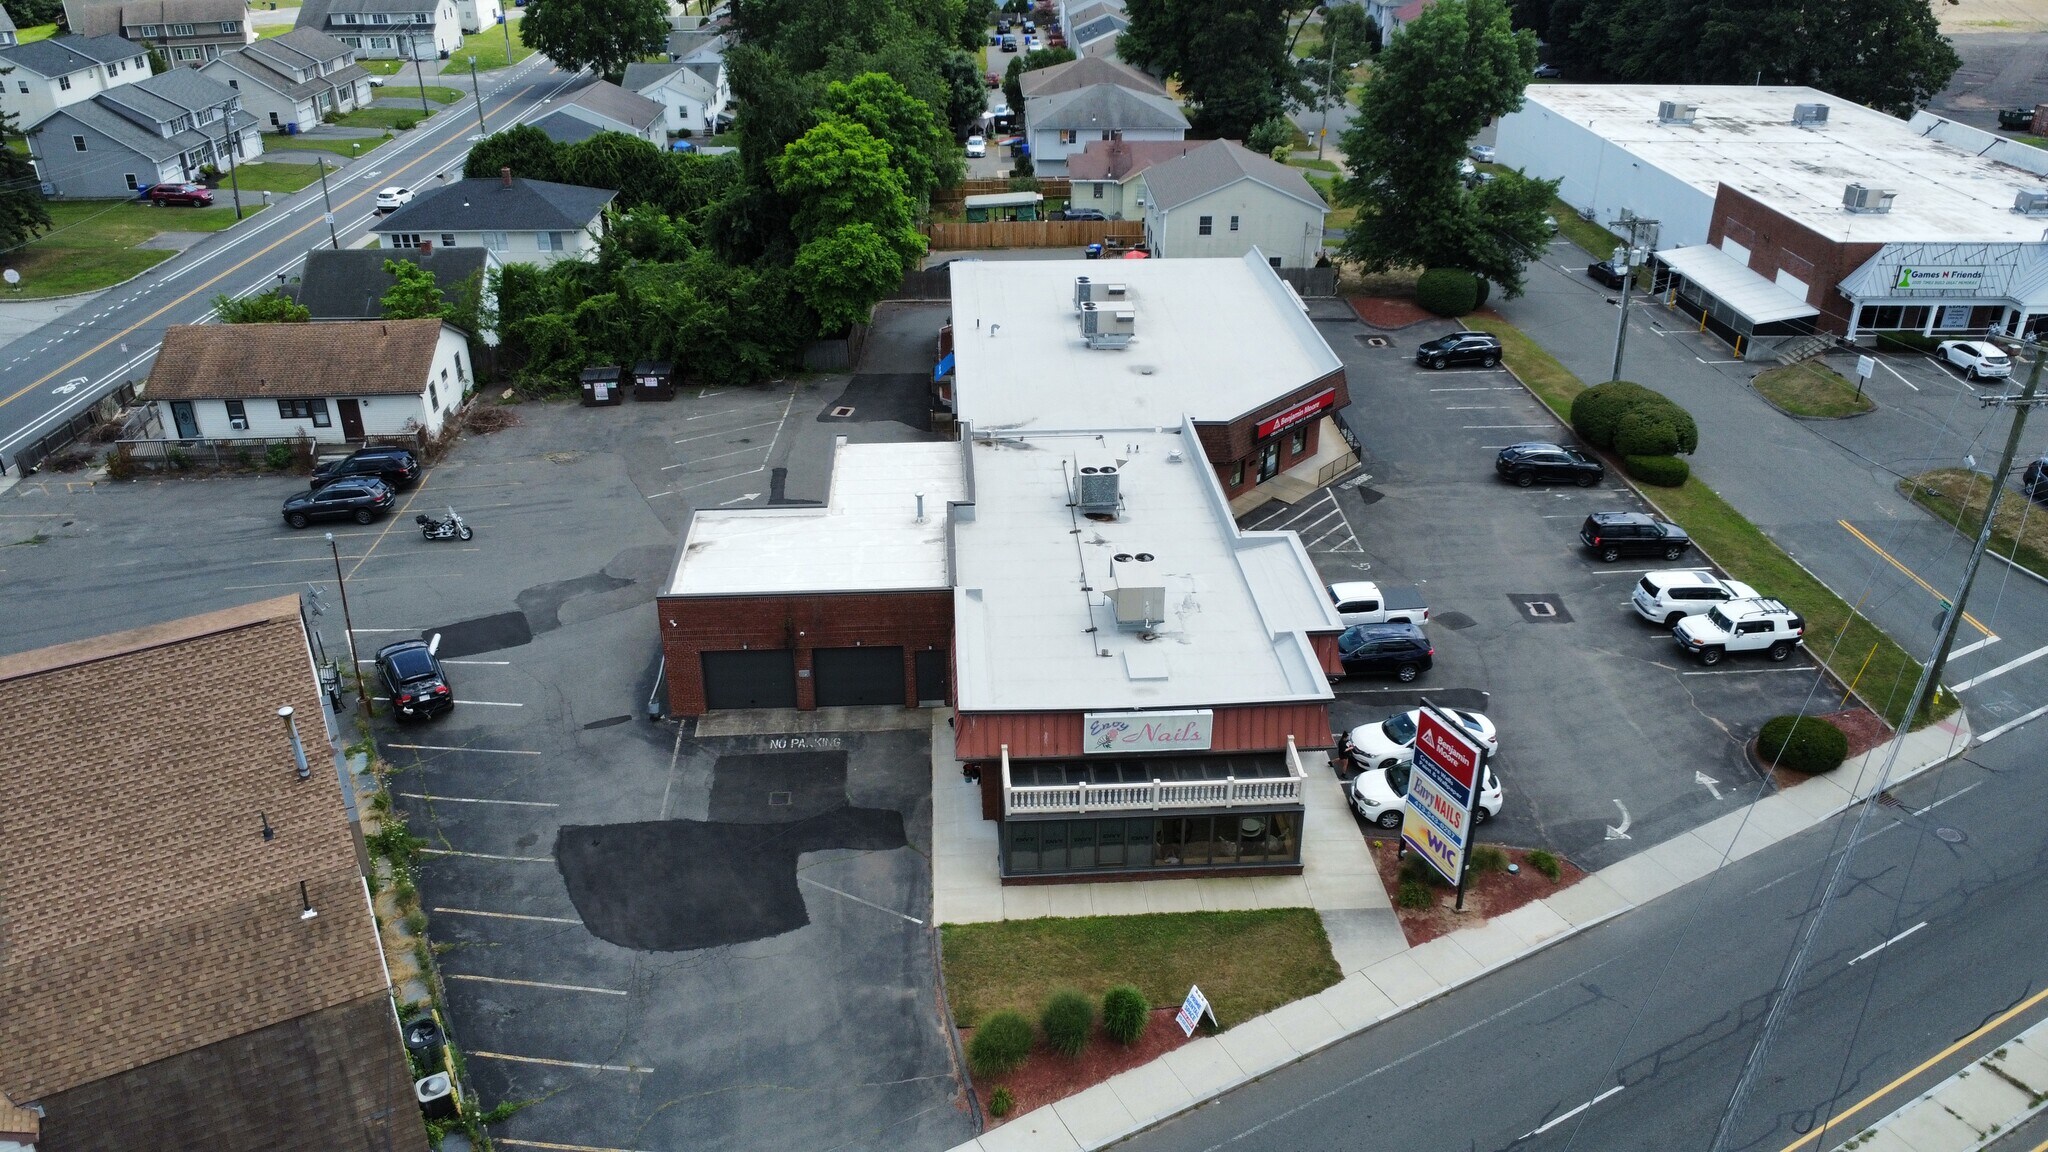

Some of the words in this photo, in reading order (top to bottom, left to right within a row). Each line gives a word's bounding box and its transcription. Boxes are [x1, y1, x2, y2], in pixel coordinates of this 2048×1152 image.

[1911, 270, 1940, 279] Games
[1951, 270, 1982, 279] Friends
[1281, 409, 1304, 426] Benjamin
[1304, 402, 1320, 414] Moore
[769, 739, 787, 749] NO
[1090, 720, 1129, 736] Envy
[1121, 721, 1202, 743] Nails
[1436, 744, 1459, 768] Moore
[1437, 735, 1470, 767] Benjamin
[1418, 760, 1432, 776] Paint
[1437, 775, 1462, 799] Wallpaper
[1419, 754, 1440, 774] Creative
[1440, 769, 1454, 786] Walls
[1434, 793, 1461, 829] NAILS
[1427, 828, 1456, 869] WIC
